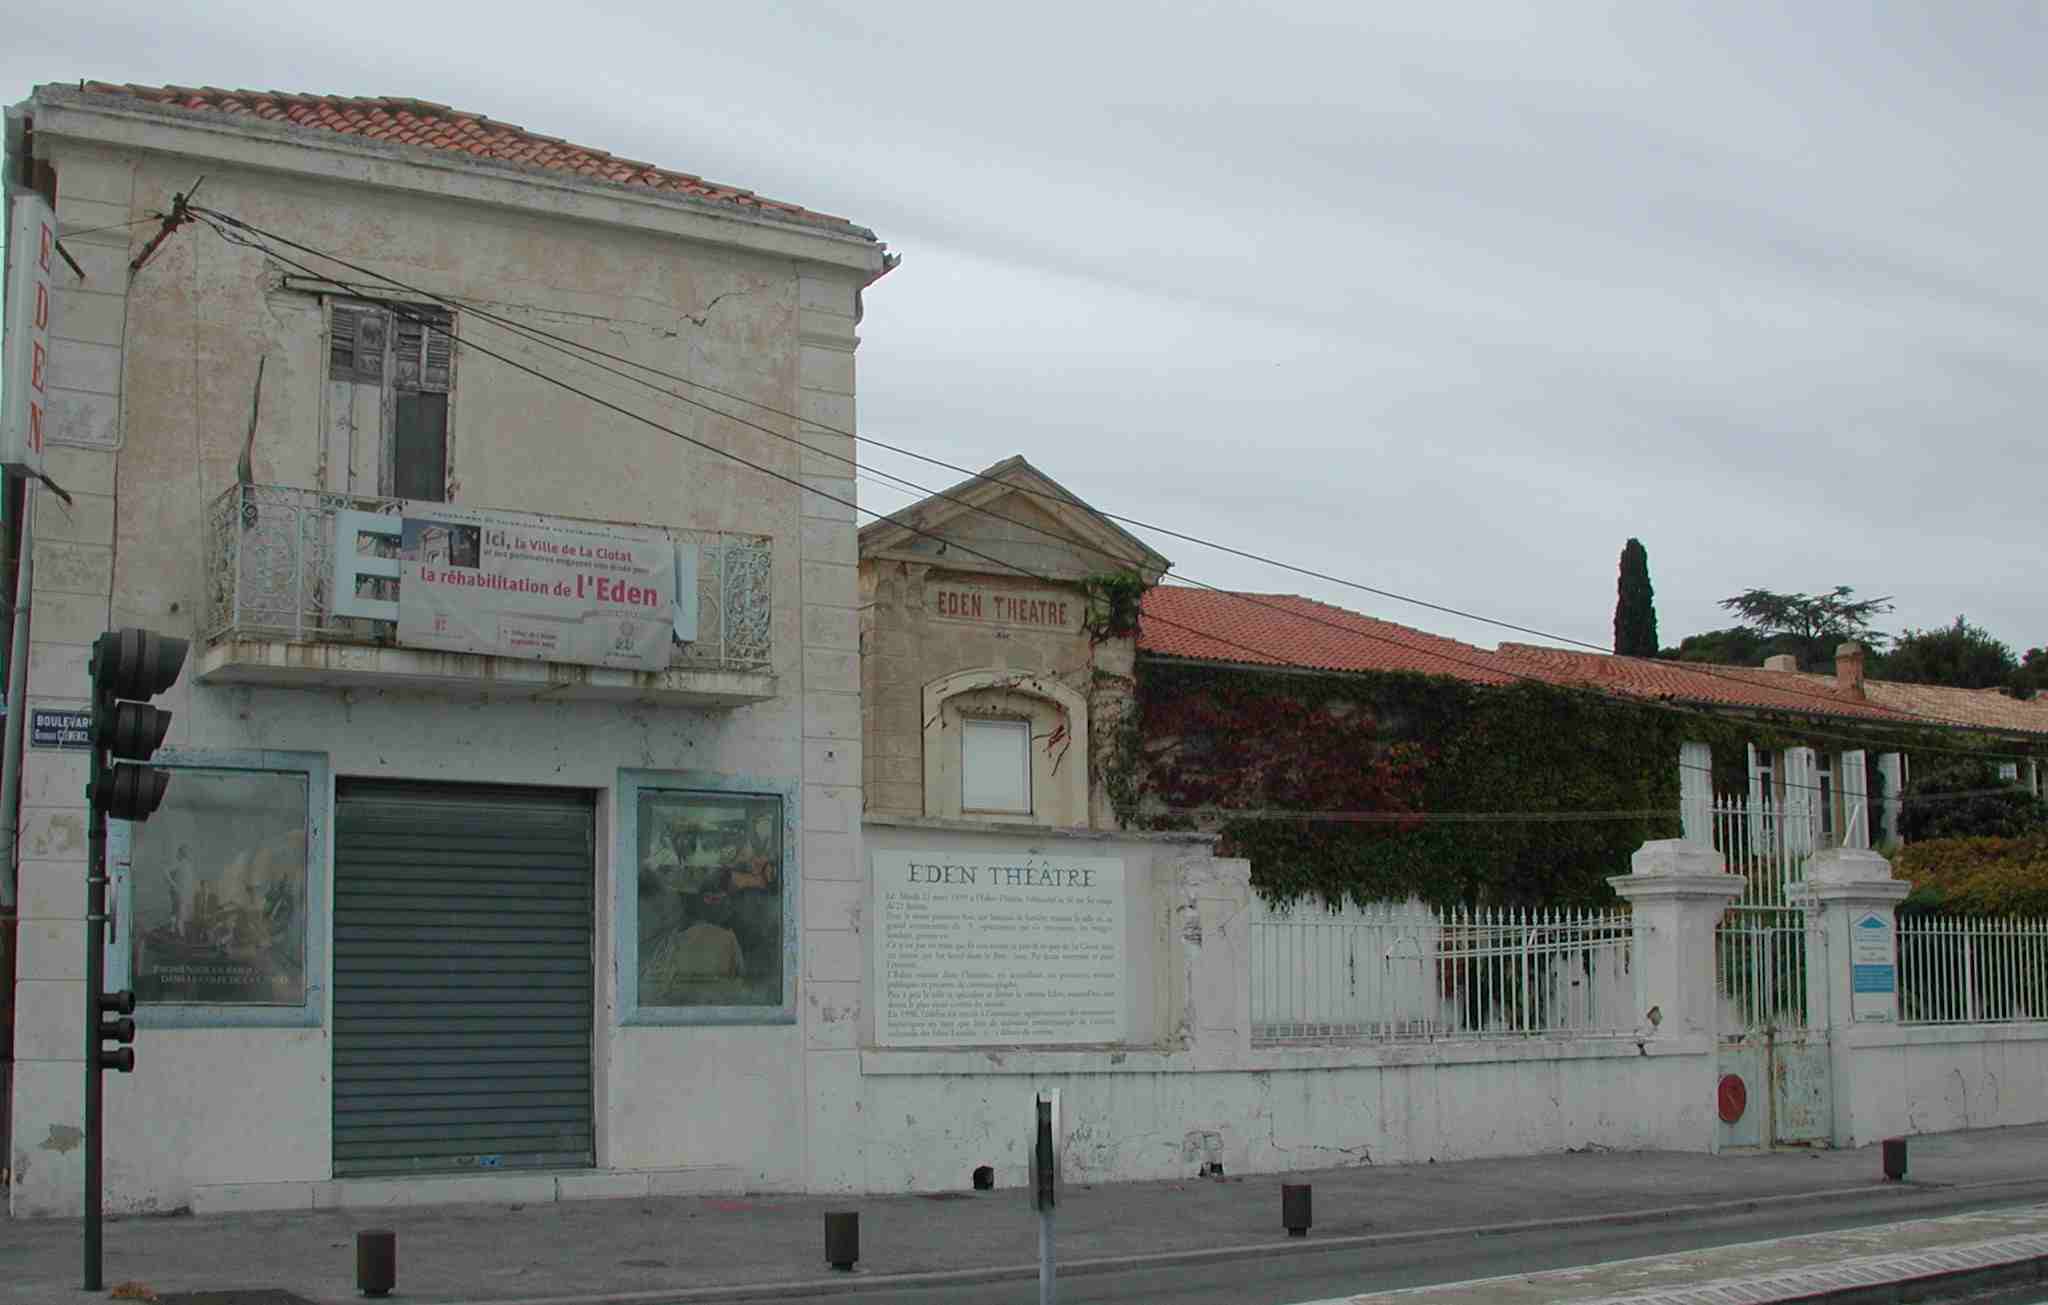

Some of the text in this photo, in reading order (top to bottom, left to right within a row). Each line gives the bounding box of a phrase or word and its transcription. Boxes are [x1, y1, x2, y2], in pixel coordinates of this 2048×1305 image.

[28, 221, 53, 454] EDEN
[485, 530, 632, 562] Ici, la Ville de La Ciotat
[421, 566, 658, 607] la réhabilitation de l'Eden
[937, 591, 1067, 625] EDEN THEATRE
[907, 859, 1097, 888] EDEN THÉÂTRE
